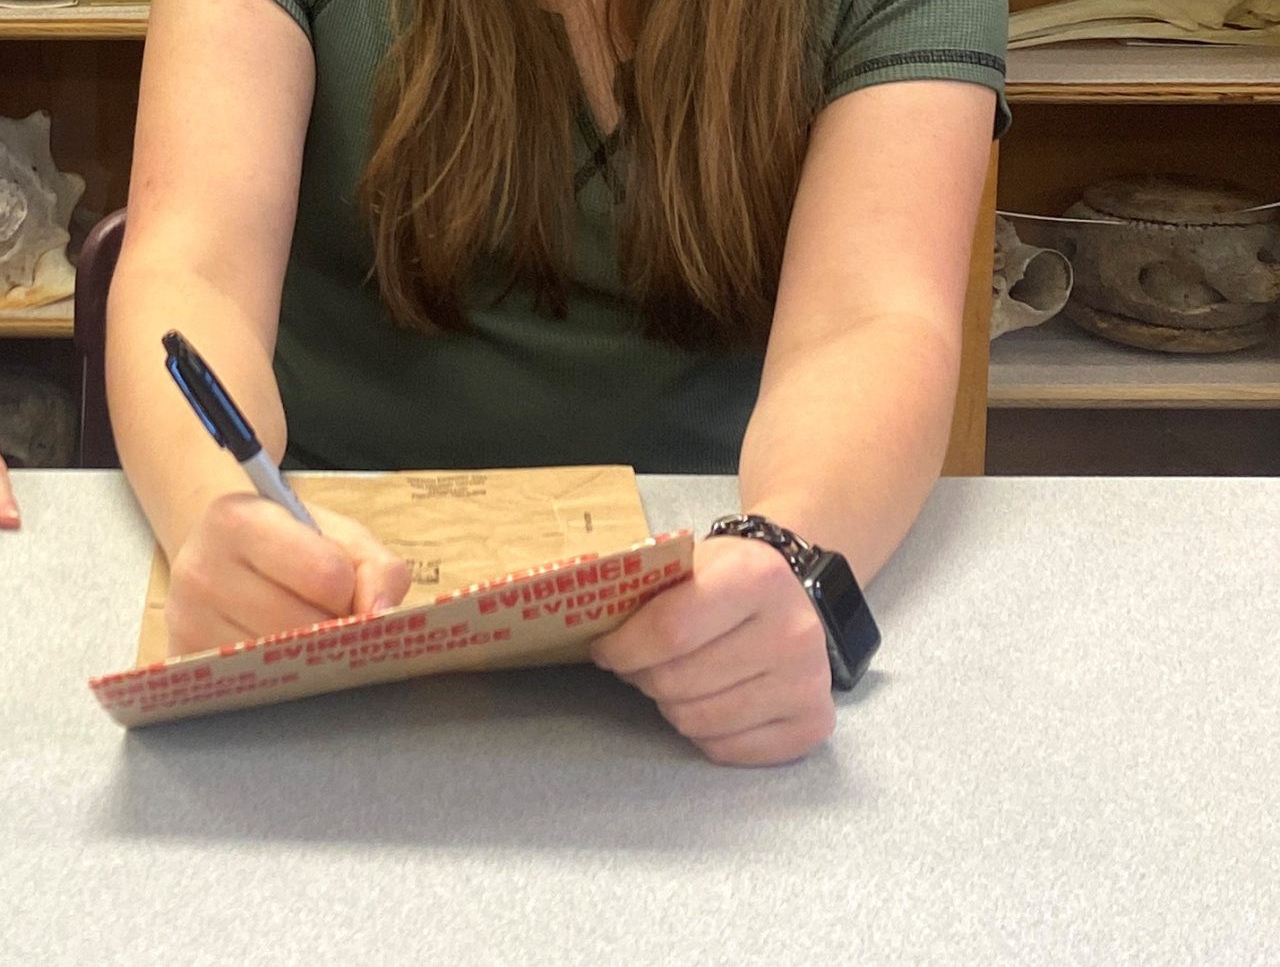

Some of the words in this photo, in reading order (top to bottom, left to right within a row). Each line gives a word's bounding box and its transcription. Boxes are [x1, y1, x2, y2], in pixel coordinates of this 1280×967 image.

[262, 612, 428, 665] EVIDENCE
[477, 550, 643, 616] EVIDENCE
[306, 623, 469, 666] EVIDENCE
[521, 558, 682, 620] EVIDENCE
[349, 627, 511, 669] EVIDENCE
